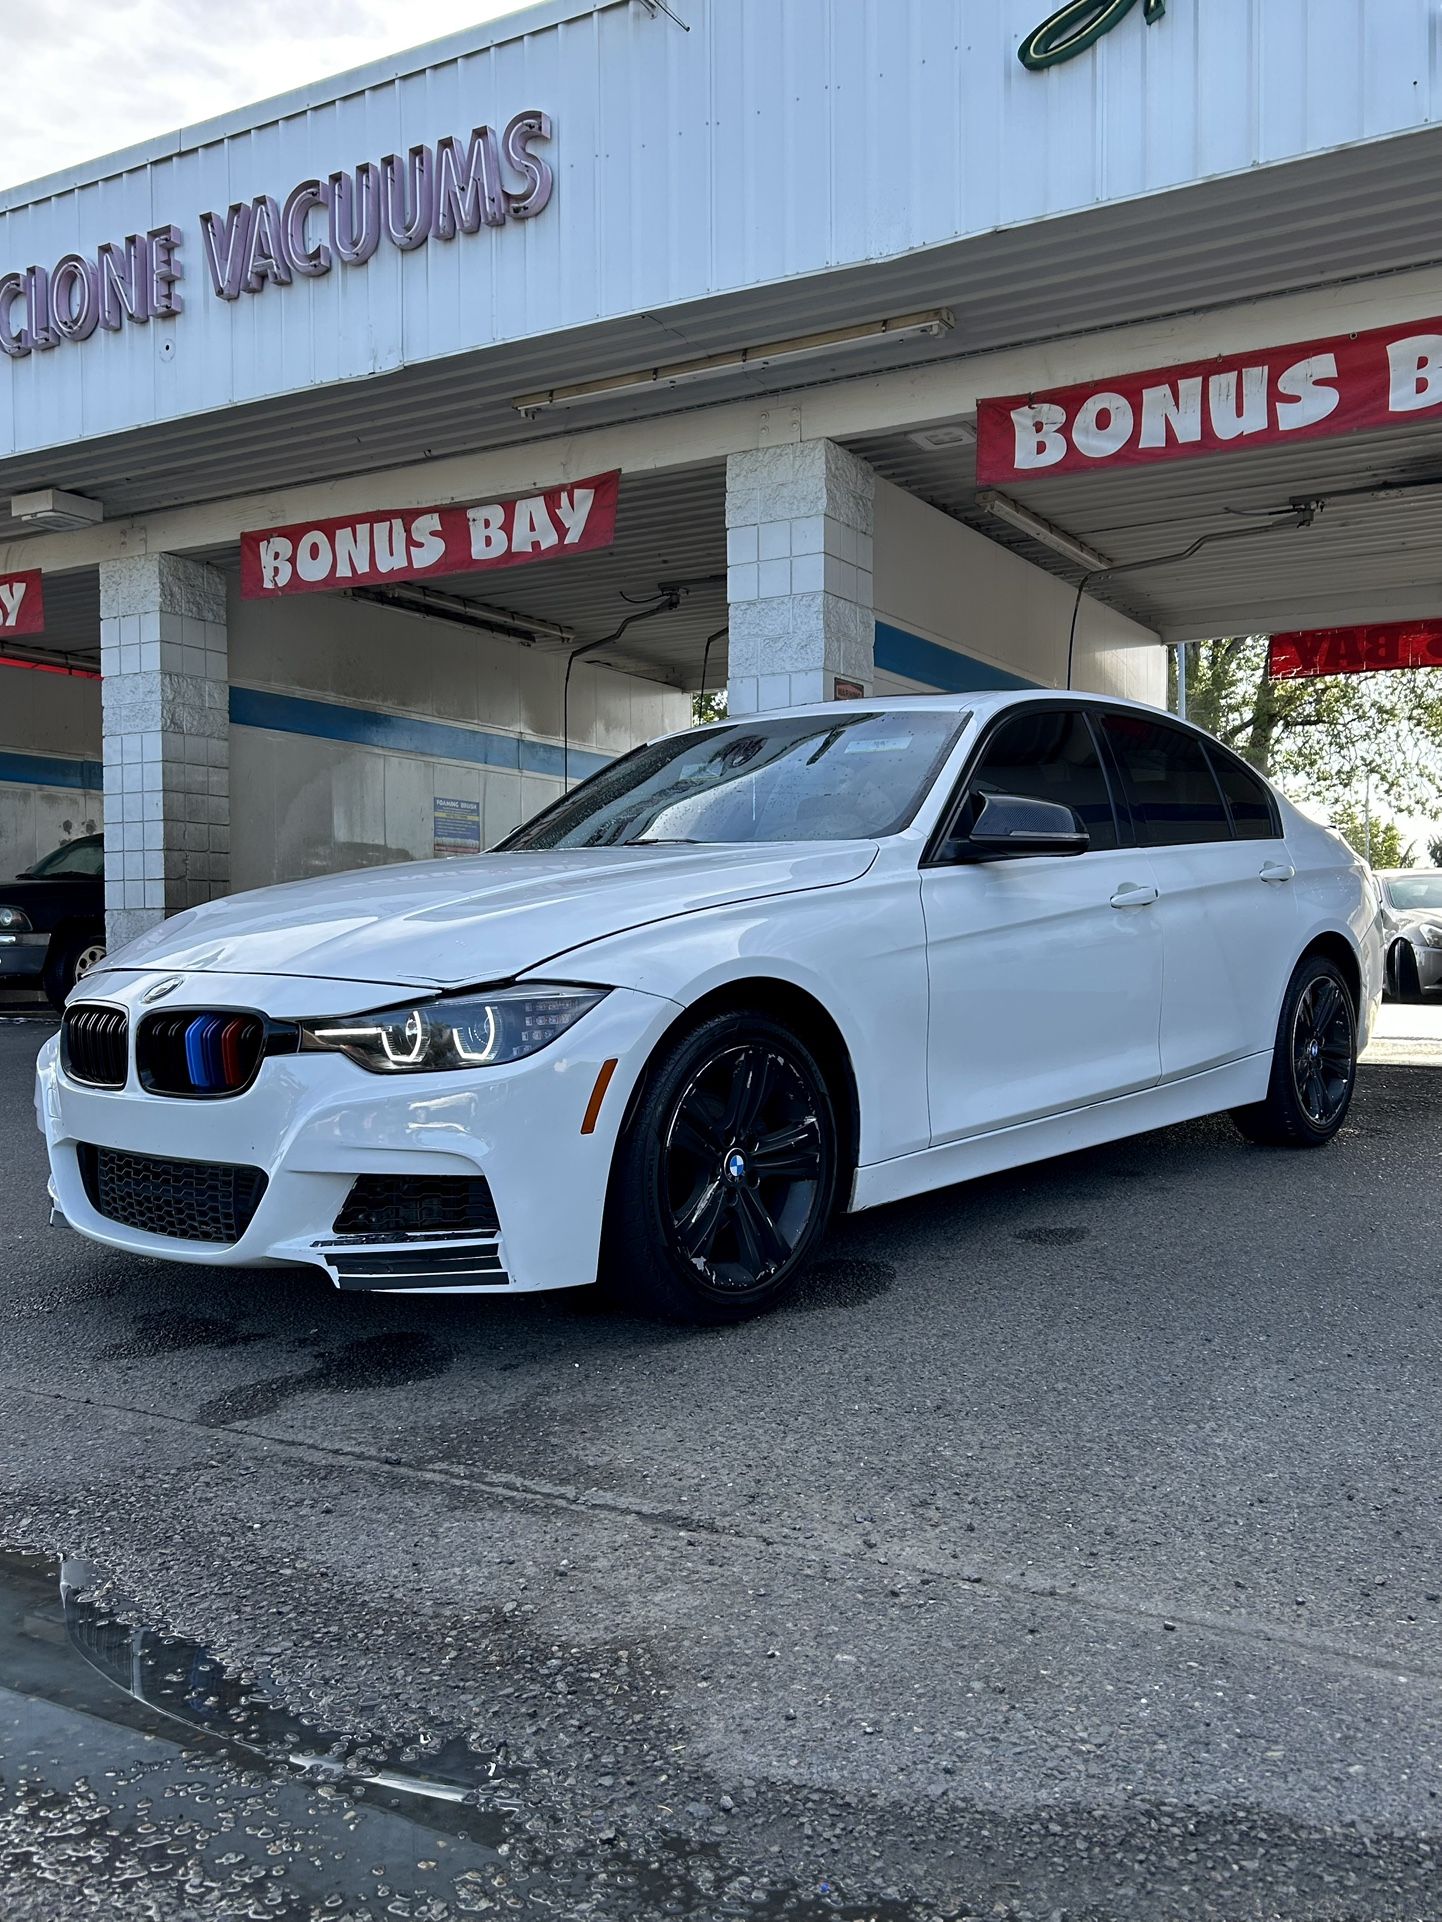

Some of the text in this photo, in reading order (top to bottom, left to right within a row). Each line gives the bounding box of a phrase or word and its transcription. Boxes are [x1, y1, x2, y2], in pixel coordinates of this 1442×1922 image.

[0, 110, 553, 358] CLONE VACUUMS
[1010, 353, 1339, 469] BONUS
[259, 488, 595, 589] BONUS BAY
[0, 582, 27, 626] Y
[436, 799, 459, 808] FOAMING
